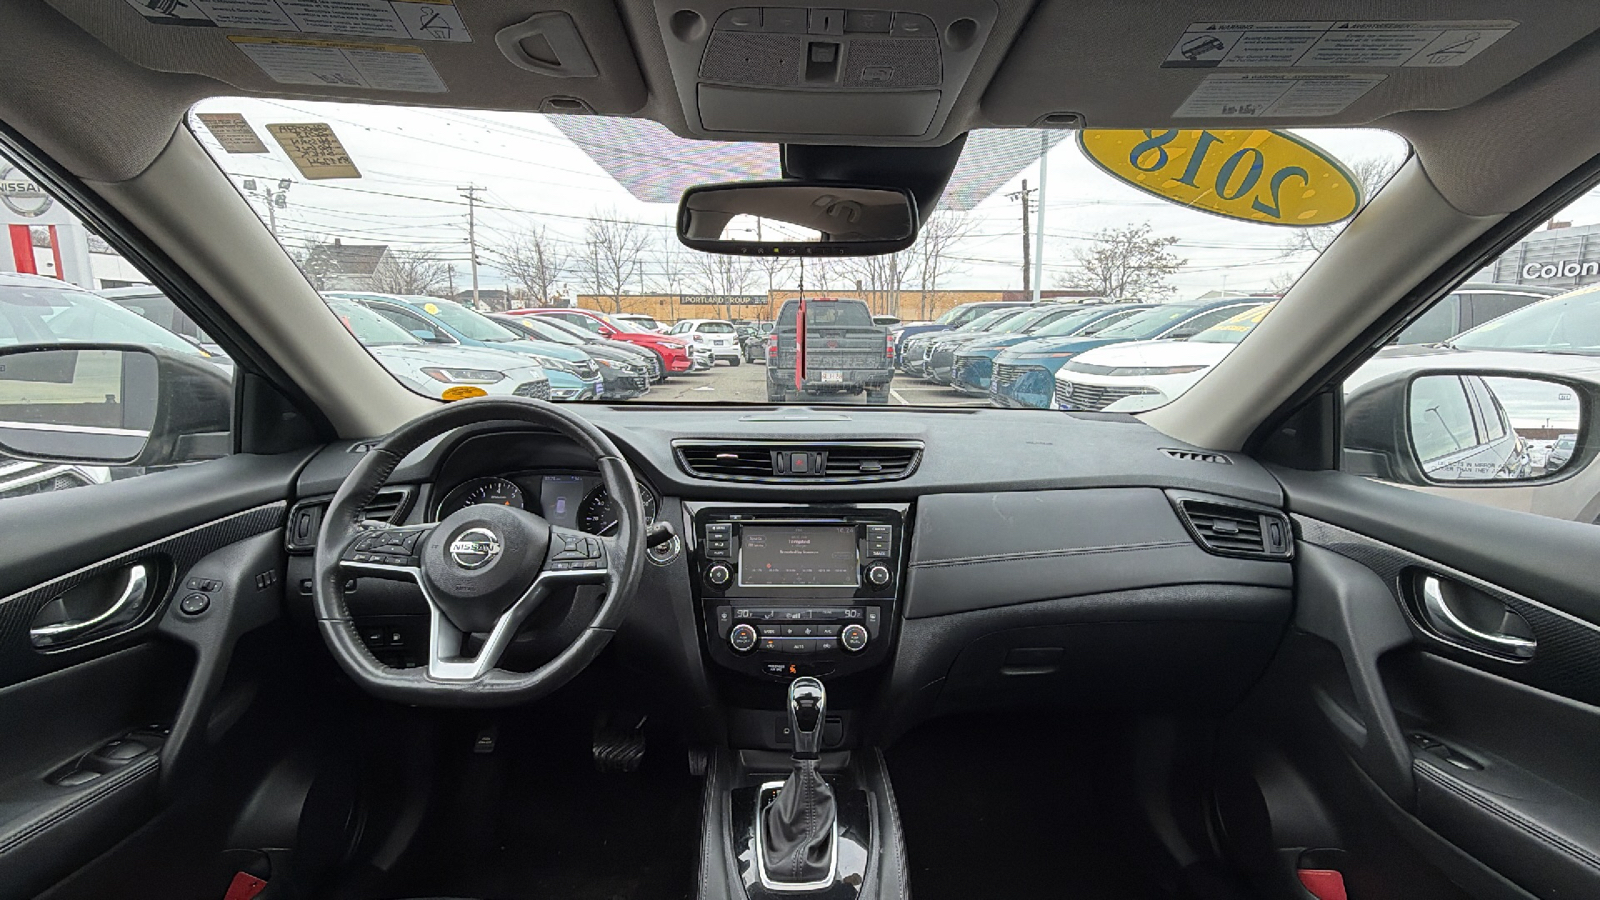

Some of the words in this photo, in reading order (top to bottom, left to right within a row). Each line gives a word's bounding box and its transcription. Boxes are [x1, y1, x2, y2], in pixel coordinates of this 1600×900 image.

[1522, 260, 1600, 280] Colon
[685, 296, 723, 304] PORTLAND
[453, 543, 494, 551] NISSAN
